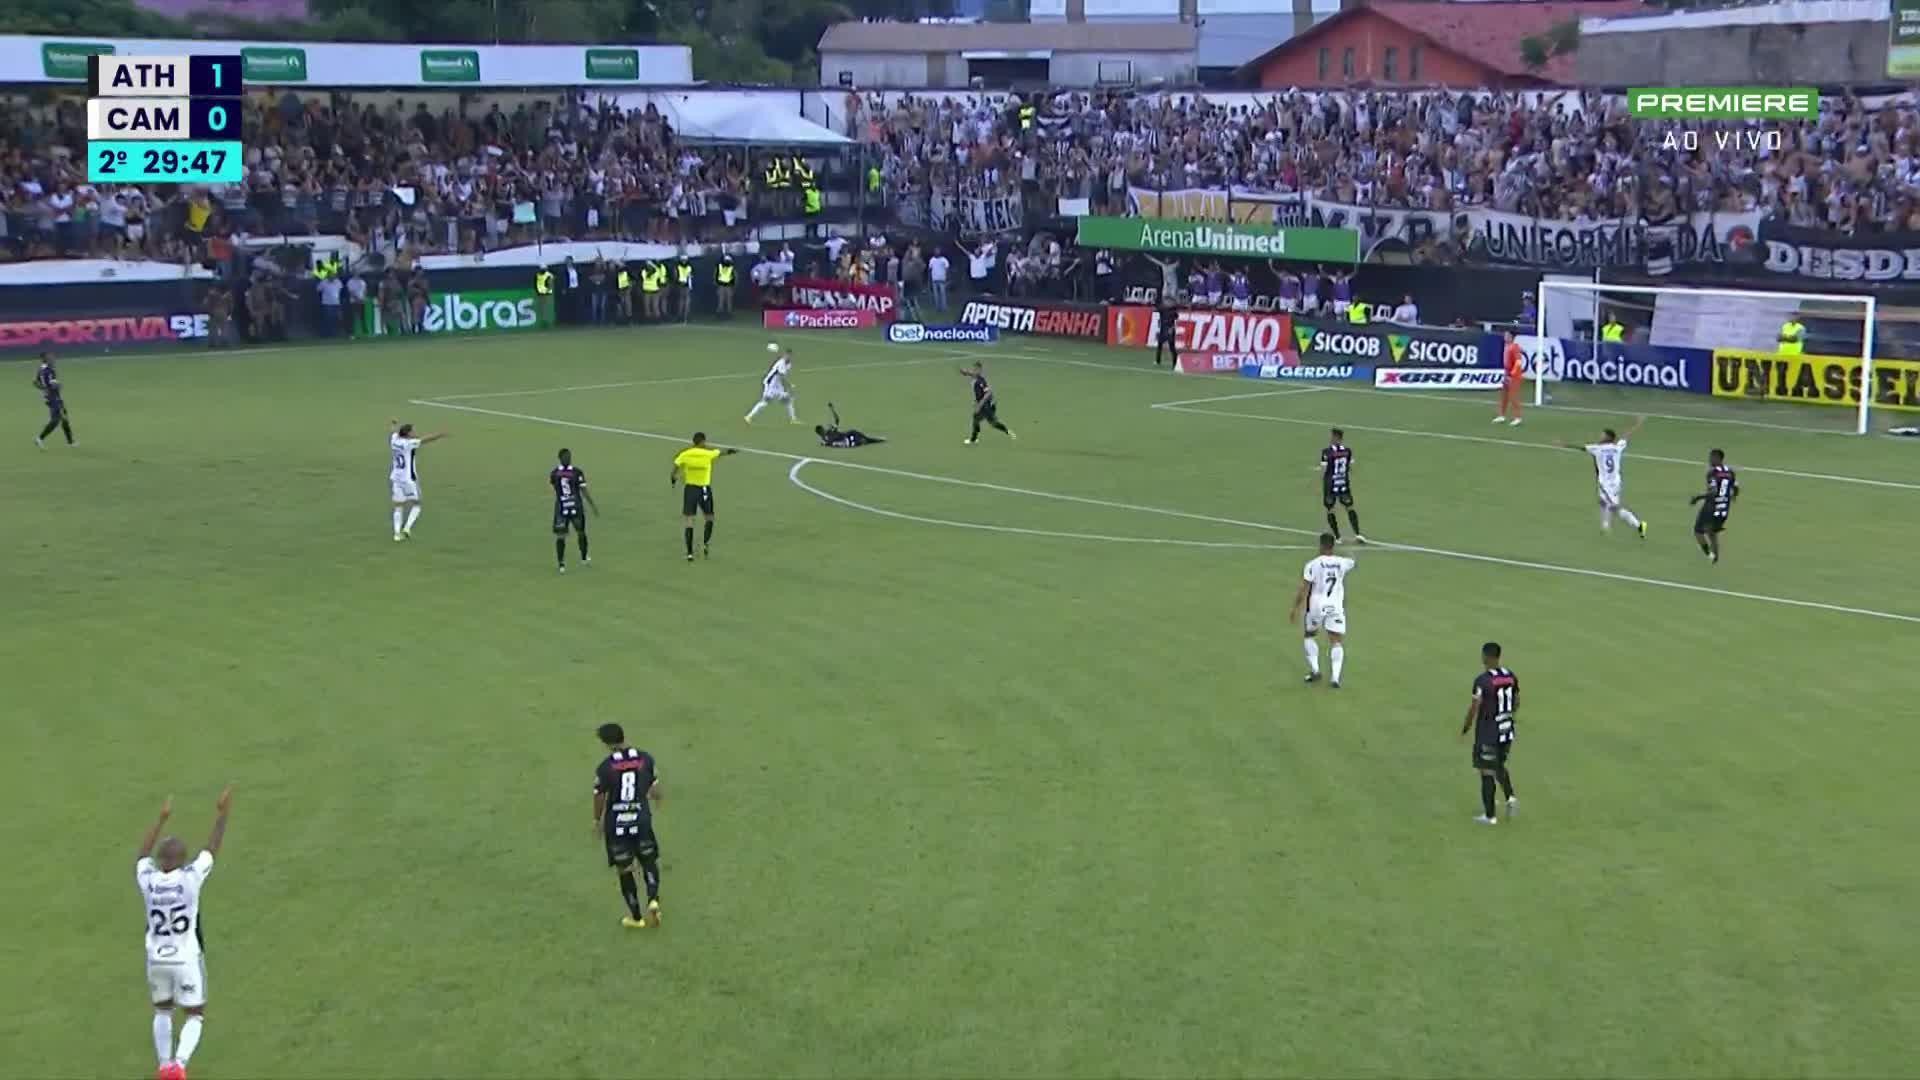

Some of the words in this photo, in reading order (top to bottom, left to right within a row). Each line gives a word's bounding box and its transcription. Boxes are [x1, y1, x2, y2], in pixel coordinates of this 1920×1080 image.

[799, 312, 859, 328] Pacheco
[1314, 331, 1380, 357] SICOOB
[1408, 339, 1479, 365] SICOOB
[1212, 351, 1284, 369] BETANO
[1279, 365, 1354, 378] GERDAU
[1605, 456, 1615, 474] 9
[1325, 576, 1337, 597] 7
[1497, 686, 1513, 713] 11
[621, 771, 636, 801] 8
[151, 904, 189, 936] 25
